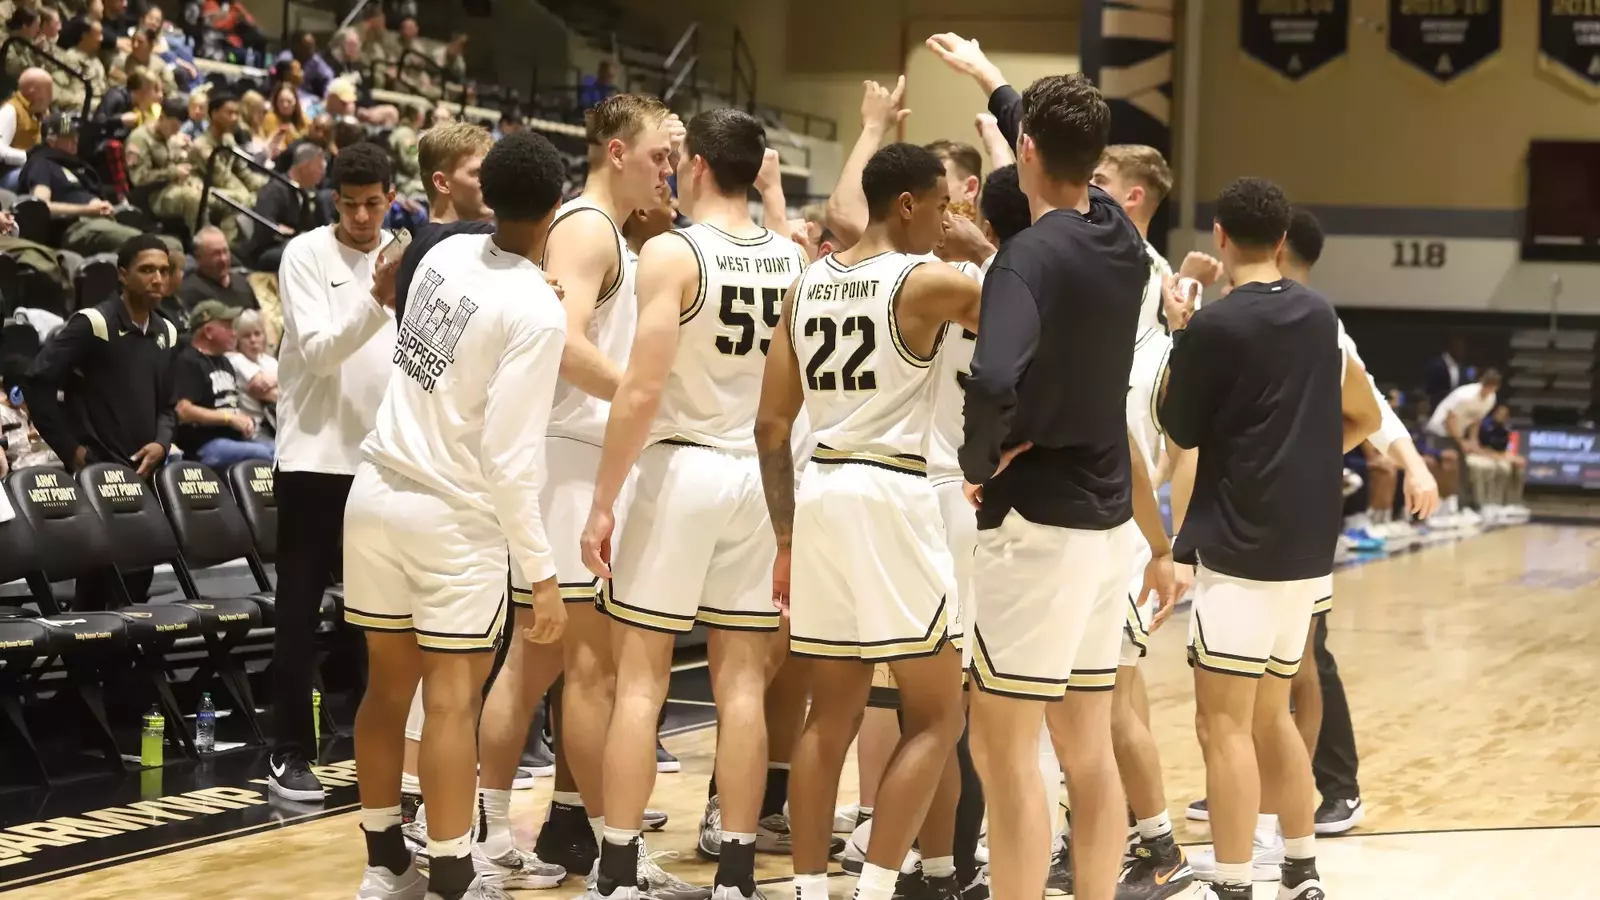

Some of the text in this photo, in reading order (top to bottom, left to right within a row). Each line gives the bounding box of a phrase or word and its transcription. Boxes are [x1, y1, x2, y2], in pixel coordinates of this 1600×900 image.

[1391, 241, 1447, 268] 118
[716, 255, 791, 273] WEST POINT
[807, 280, 880, 301] WEST POINT
[397, 327, 447, 377] SAPPERS
[804, 316, 877, 391] 22
[393, 345, 436, 394] ORWARD!
[1529, 430, 1595, 453] Military
[35, 473, 58, 488] ARMY
[103, 470, 126, 483] ARMY
[183, 468, 204, 481] ARMY
[254, 466, 273, 479] ARMY
[28, 487, 77, 503] WEST POINT
[98, 482, 143, 498] WEST POINT
[178, 480, 220, 494] WEST POINT
[0, 787, 268, 867] ARMYWP
